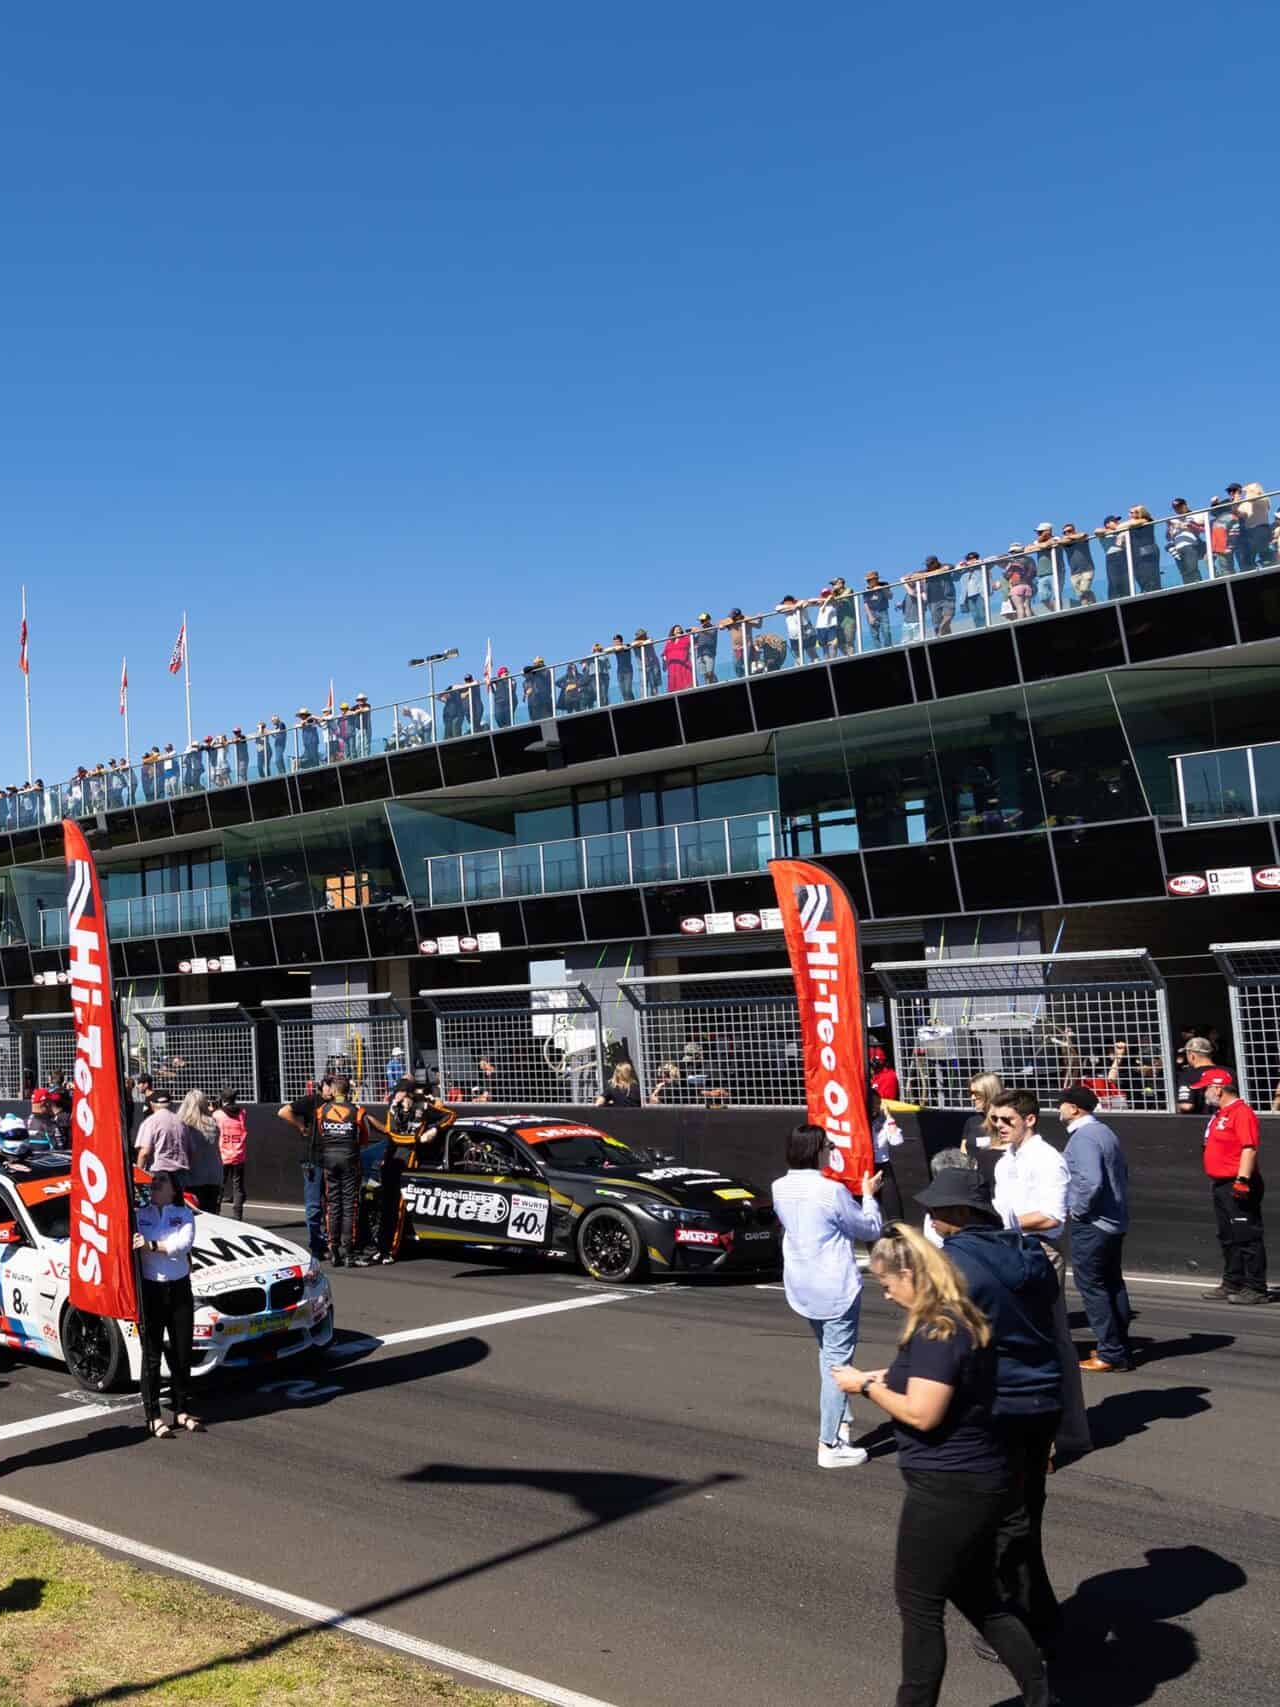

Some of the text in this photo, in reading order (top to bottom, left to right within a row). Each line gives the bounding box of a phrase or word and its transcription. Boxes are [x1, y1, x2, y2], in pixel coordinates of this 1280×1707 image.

[803, 930, 840, 1071] Hi-Tec
[69, 927, 109, 1288] Hi-Tec Oils
[323, 1121, 353, 1130] boost
[407, 1184, 432, 1195] Euro
[677, 1230, 718, 1243] MRF
